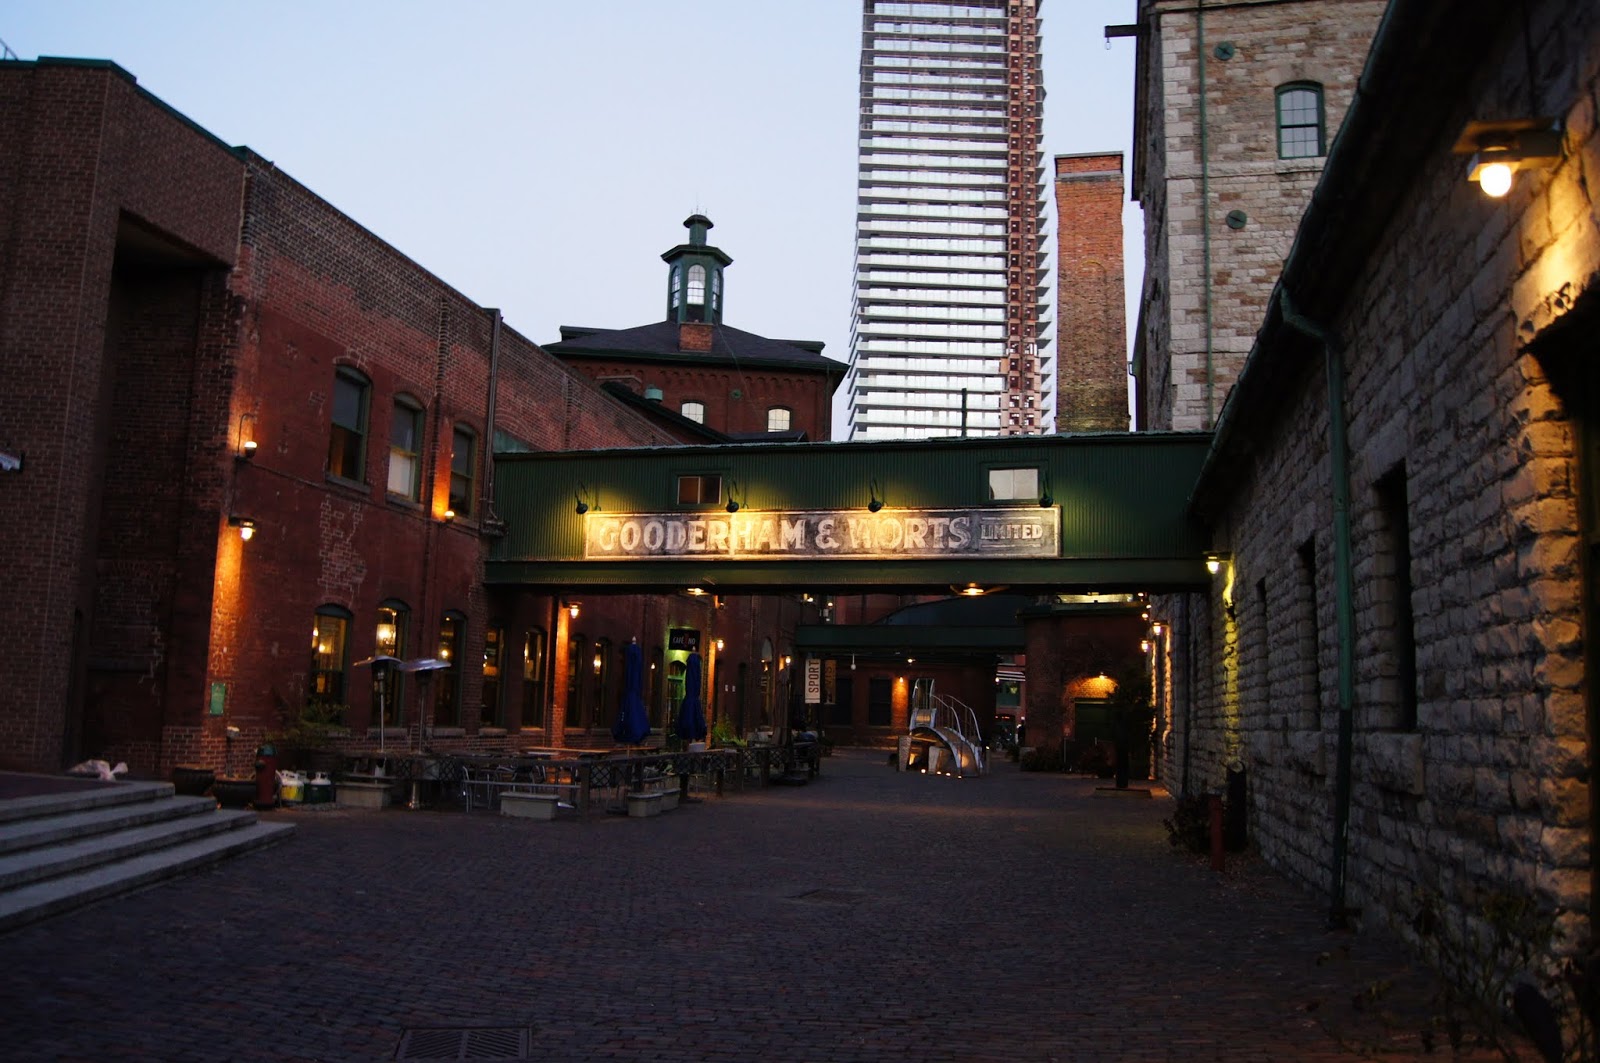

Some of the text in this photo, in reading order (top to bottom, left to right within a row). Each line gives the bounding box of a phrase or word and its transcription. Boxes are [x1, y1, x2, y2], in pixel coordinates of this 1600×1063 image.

[599, 516, 1043, 551] GOODERHAM & WORTS LIMITED
[808, 660, 819, 693] SPORT
